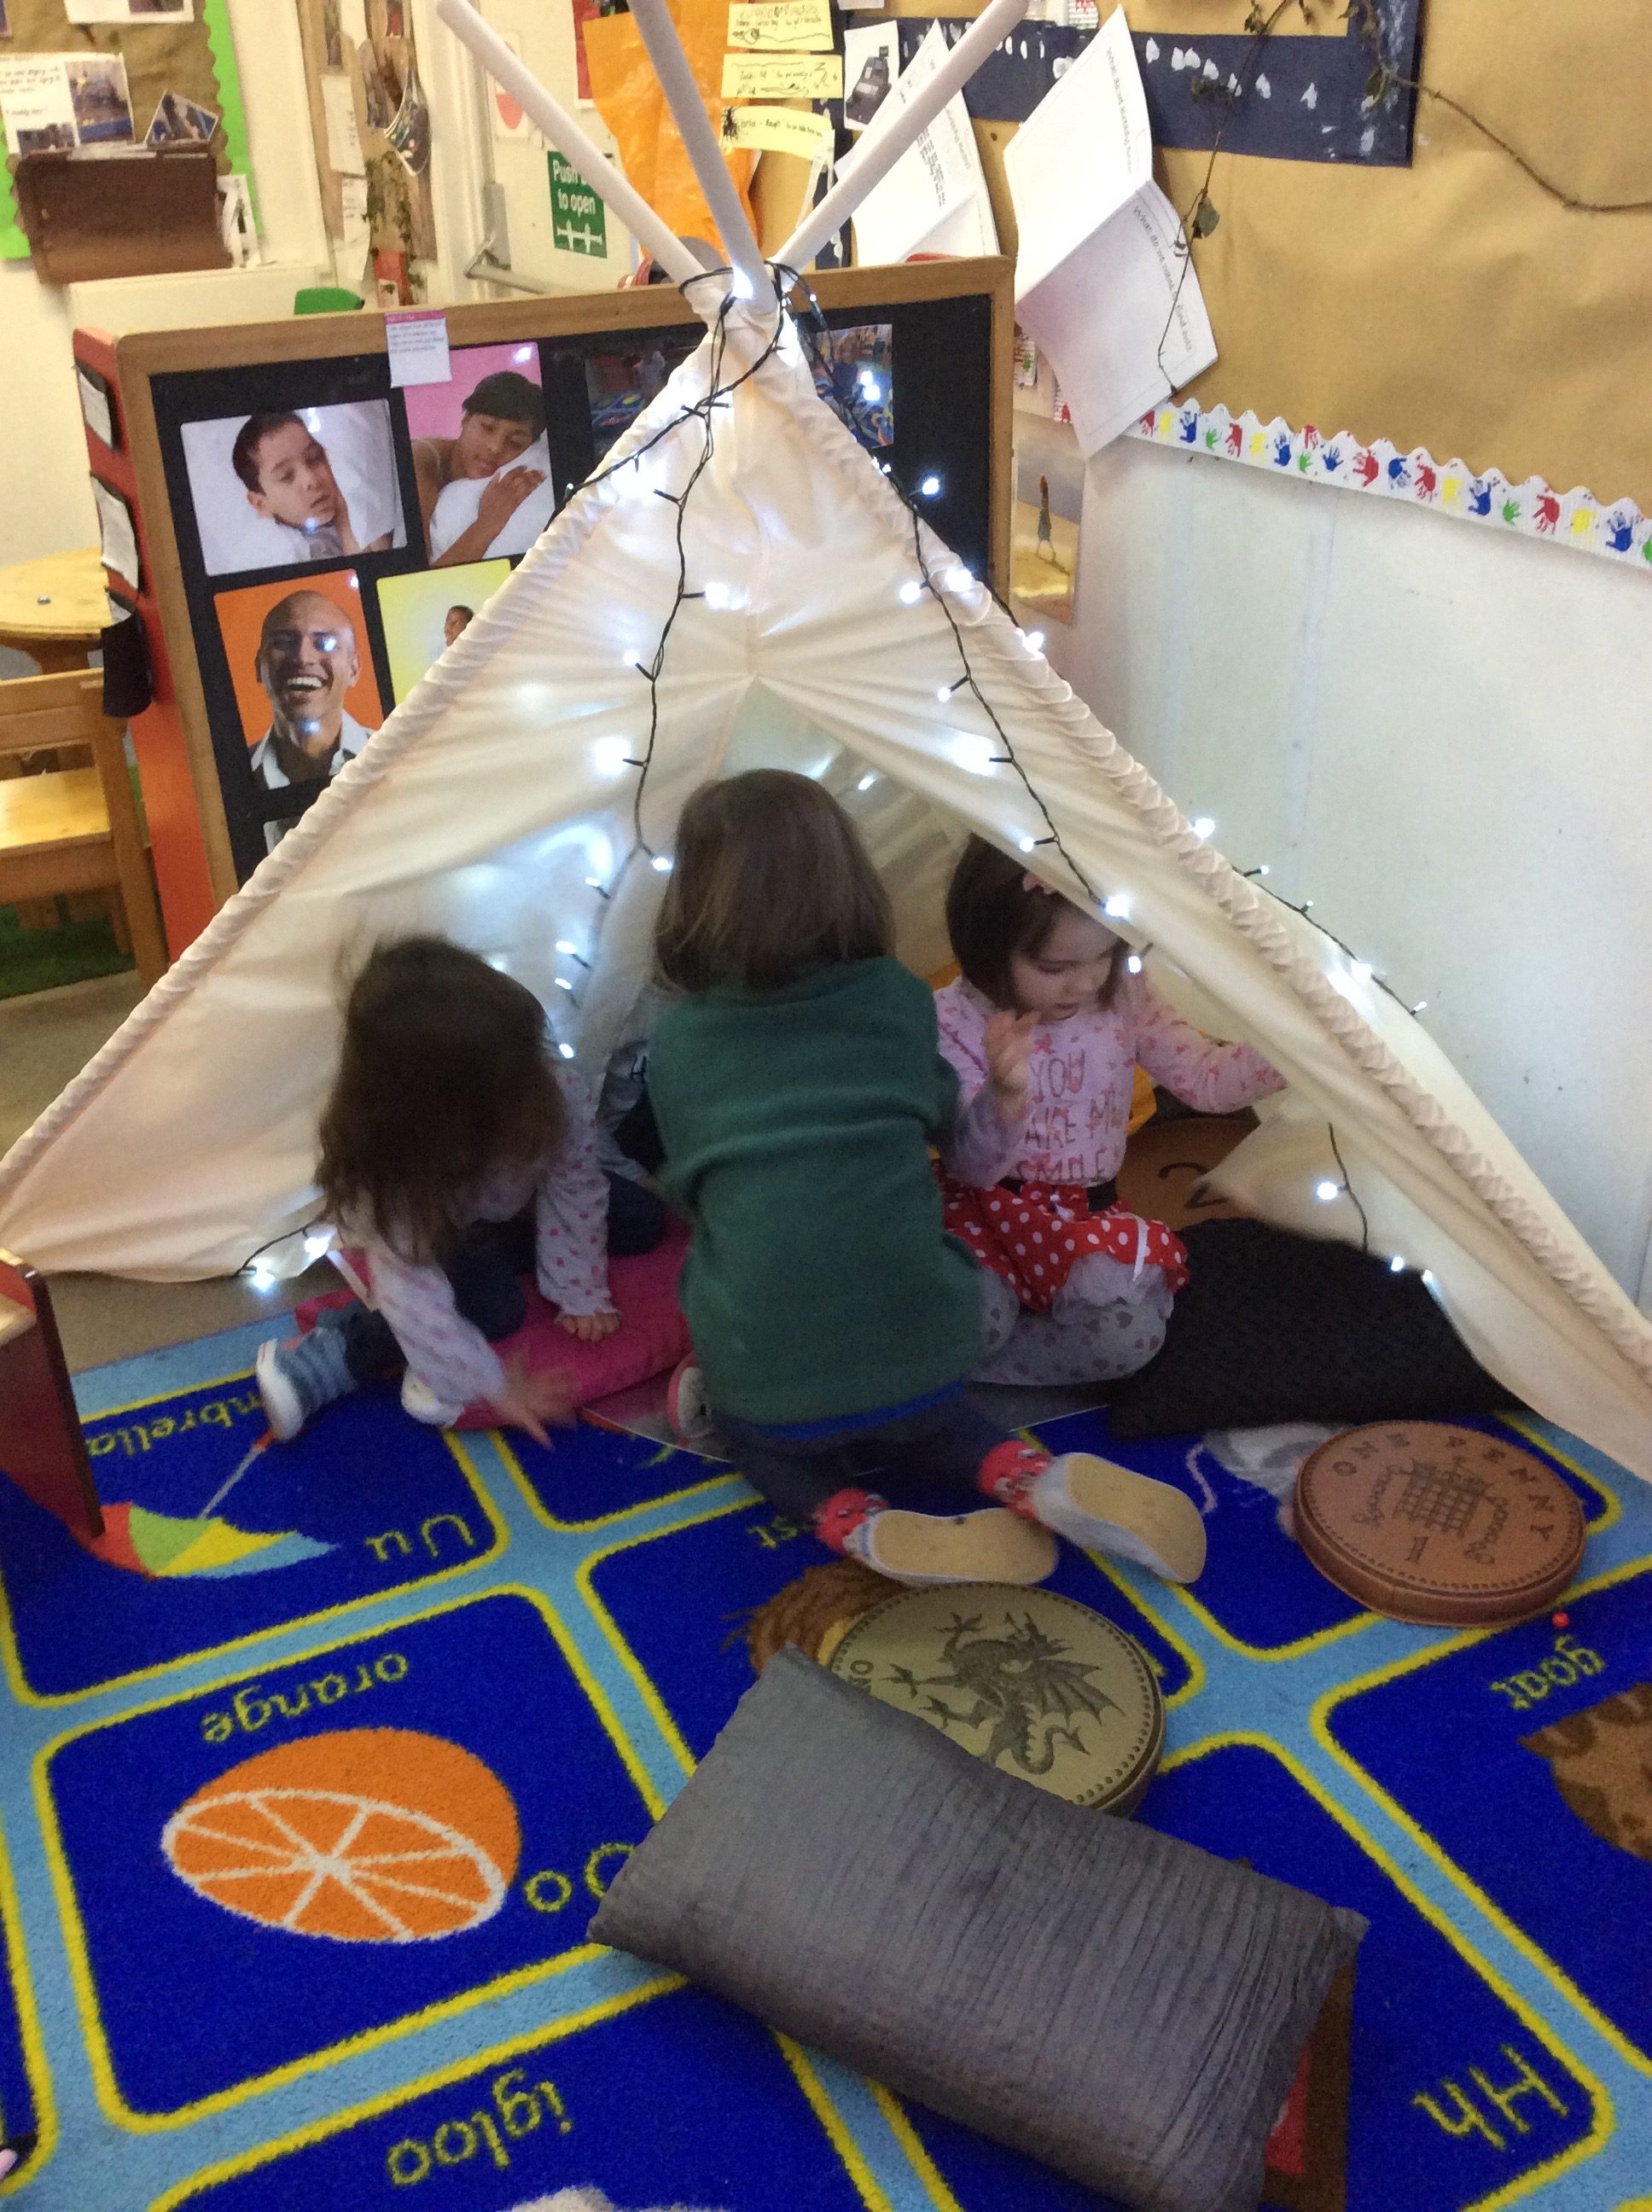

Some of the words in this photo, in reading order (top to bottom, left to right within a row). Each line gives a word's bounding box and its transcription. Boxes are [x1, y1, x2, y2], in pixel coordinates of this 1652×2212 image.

[557, 188, 569, 211] to
[570, 193, 596, 218] open
[1133, 205, 1153, 233] What
[1150, 233, 1160, 247] do
[1156, 247, 1166, 262] we
[1162, 265, 1177, 291] want
[1175, 304, 1188, 329] find
[1029, 1049, 1086, 1103] YOU
[1024, 1106, 1077, 1150] ARE
[85, 1390, 263, 1458] mbrella
[1331, 1431, 1412, 1478] ONE
[1446, 1434, 1557, 1543] PENNY
[364, 1512, 476, 1563] Uu
[201, 1651, 410, 1743] orange
[1490, 1633, 1606, 1711] goat
[386, 2068, 573, 2186] igloo
[1411, 2044, 1569, 2151] Hh
